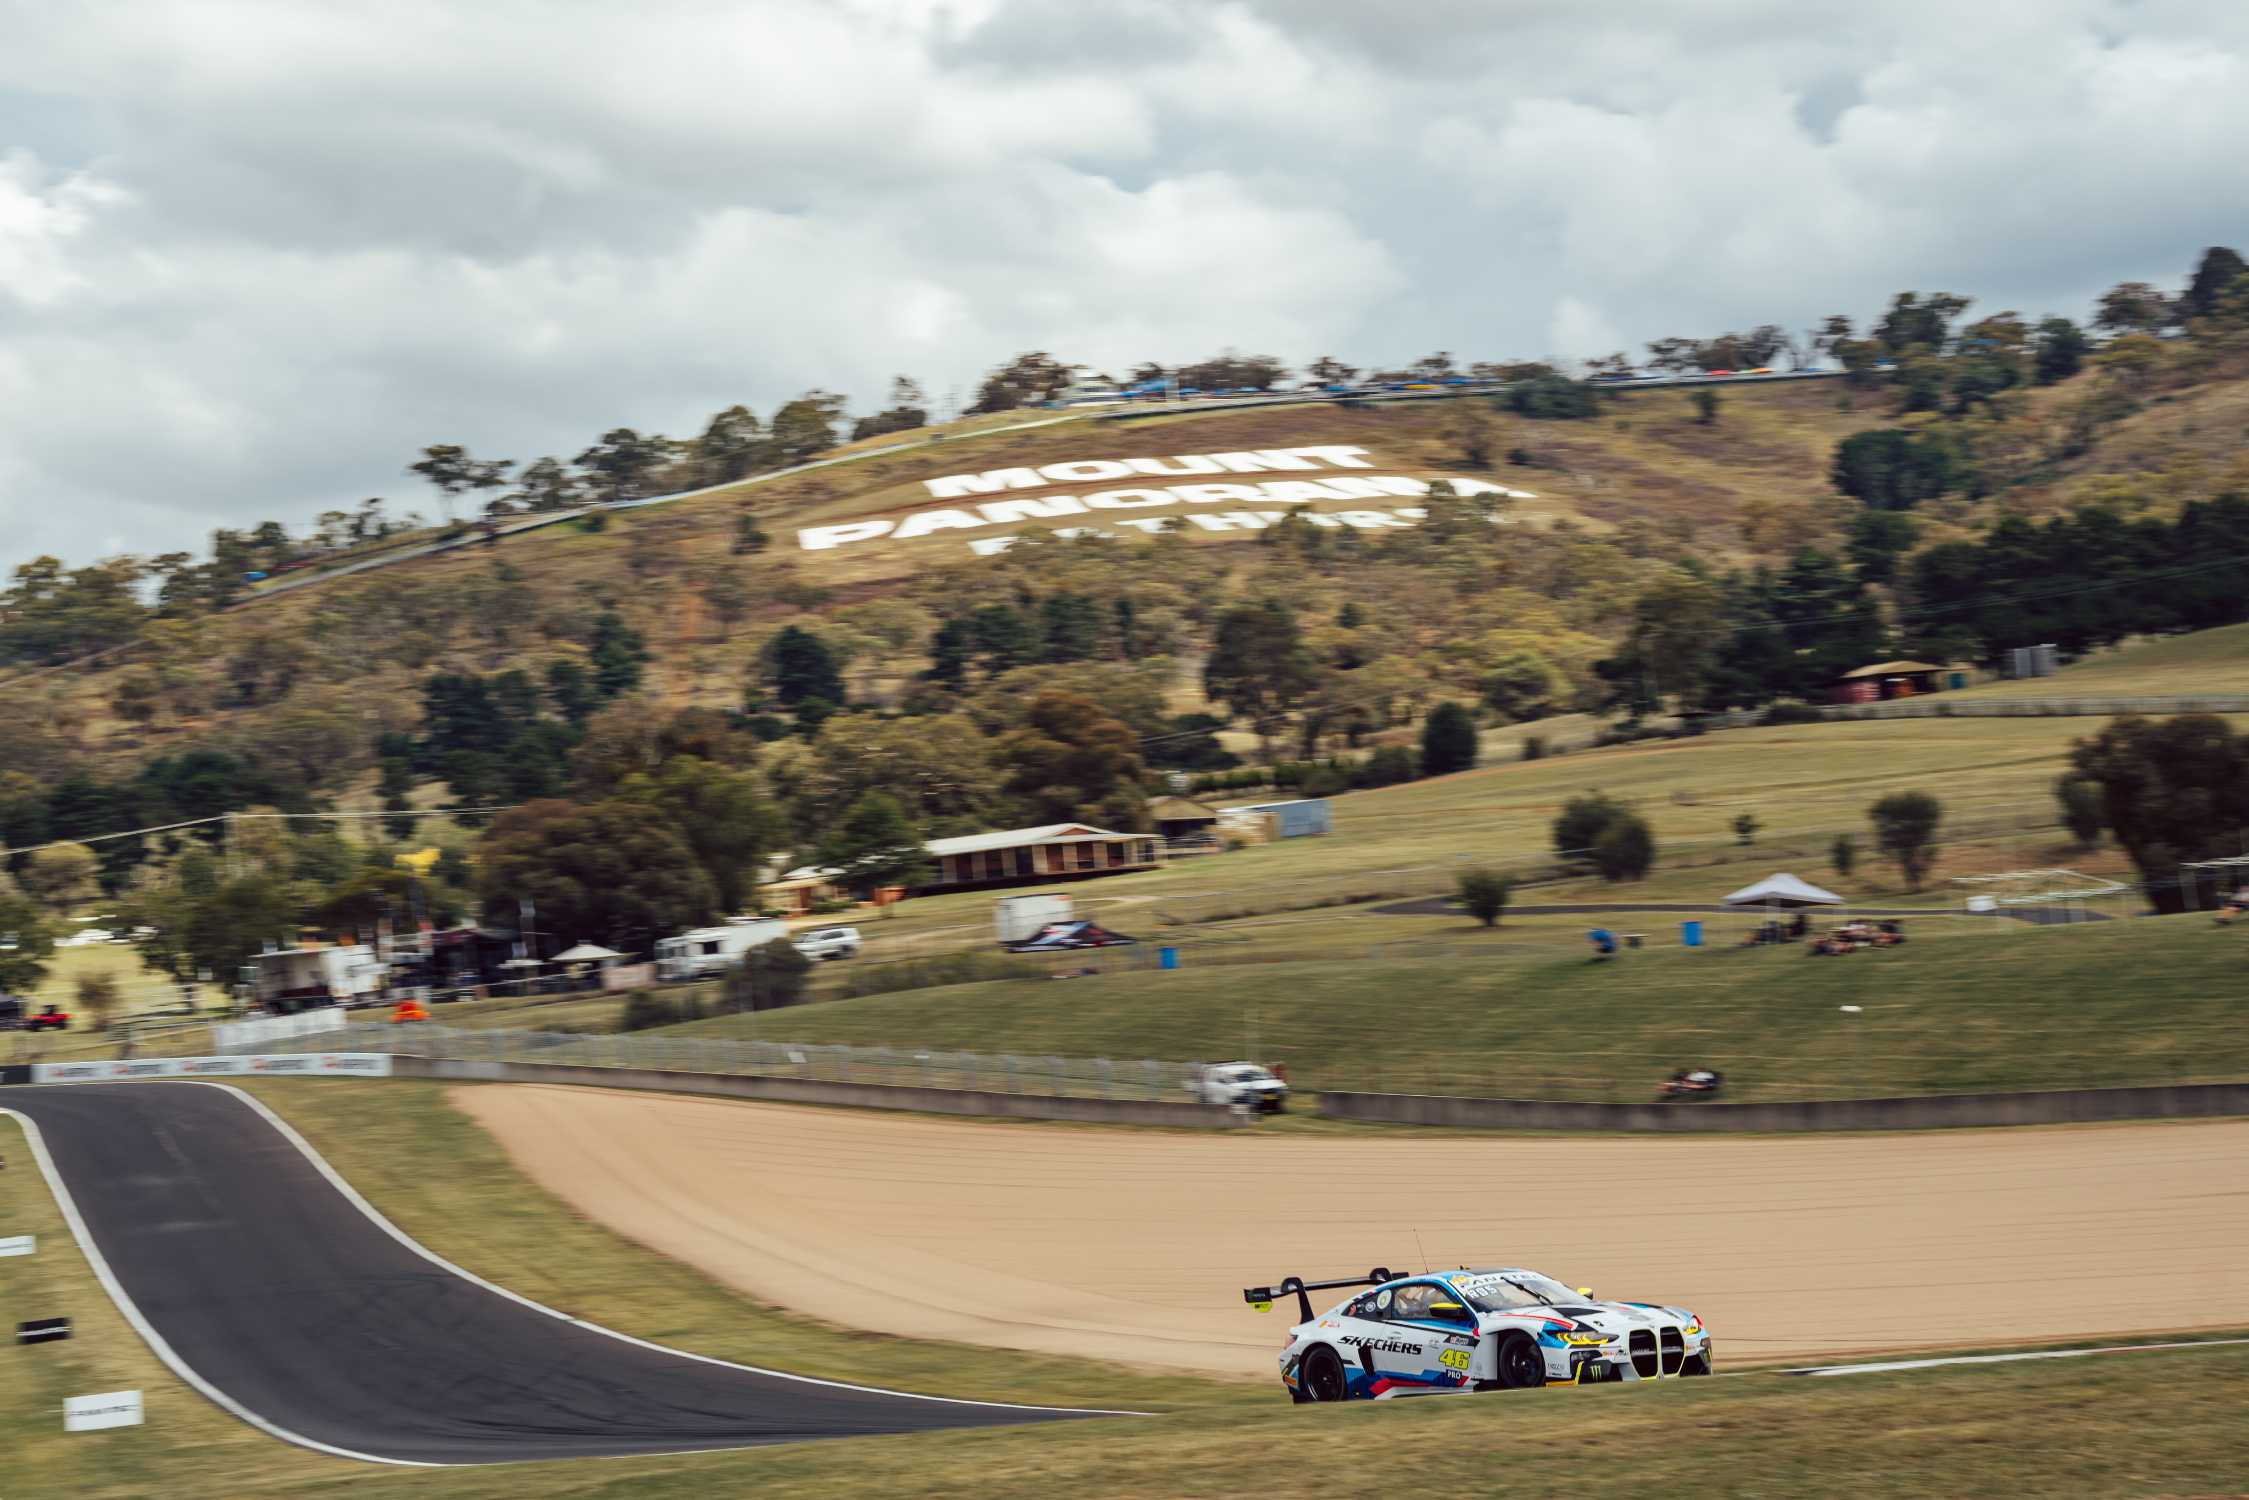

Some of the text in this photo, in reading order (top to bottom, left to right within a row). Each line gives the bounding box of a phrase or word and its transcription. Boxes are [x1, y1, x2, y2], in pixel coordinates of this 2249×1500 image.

[923, 445, 1375, 498] MOUNT
[797, 475, 1538, 550] PANORAMA
[1337, 1335, 1423, 1355] SKECHERS
[1438, 1348, 1471, 1370] 46
[1447, 1370, 1461, 1379] PRO
